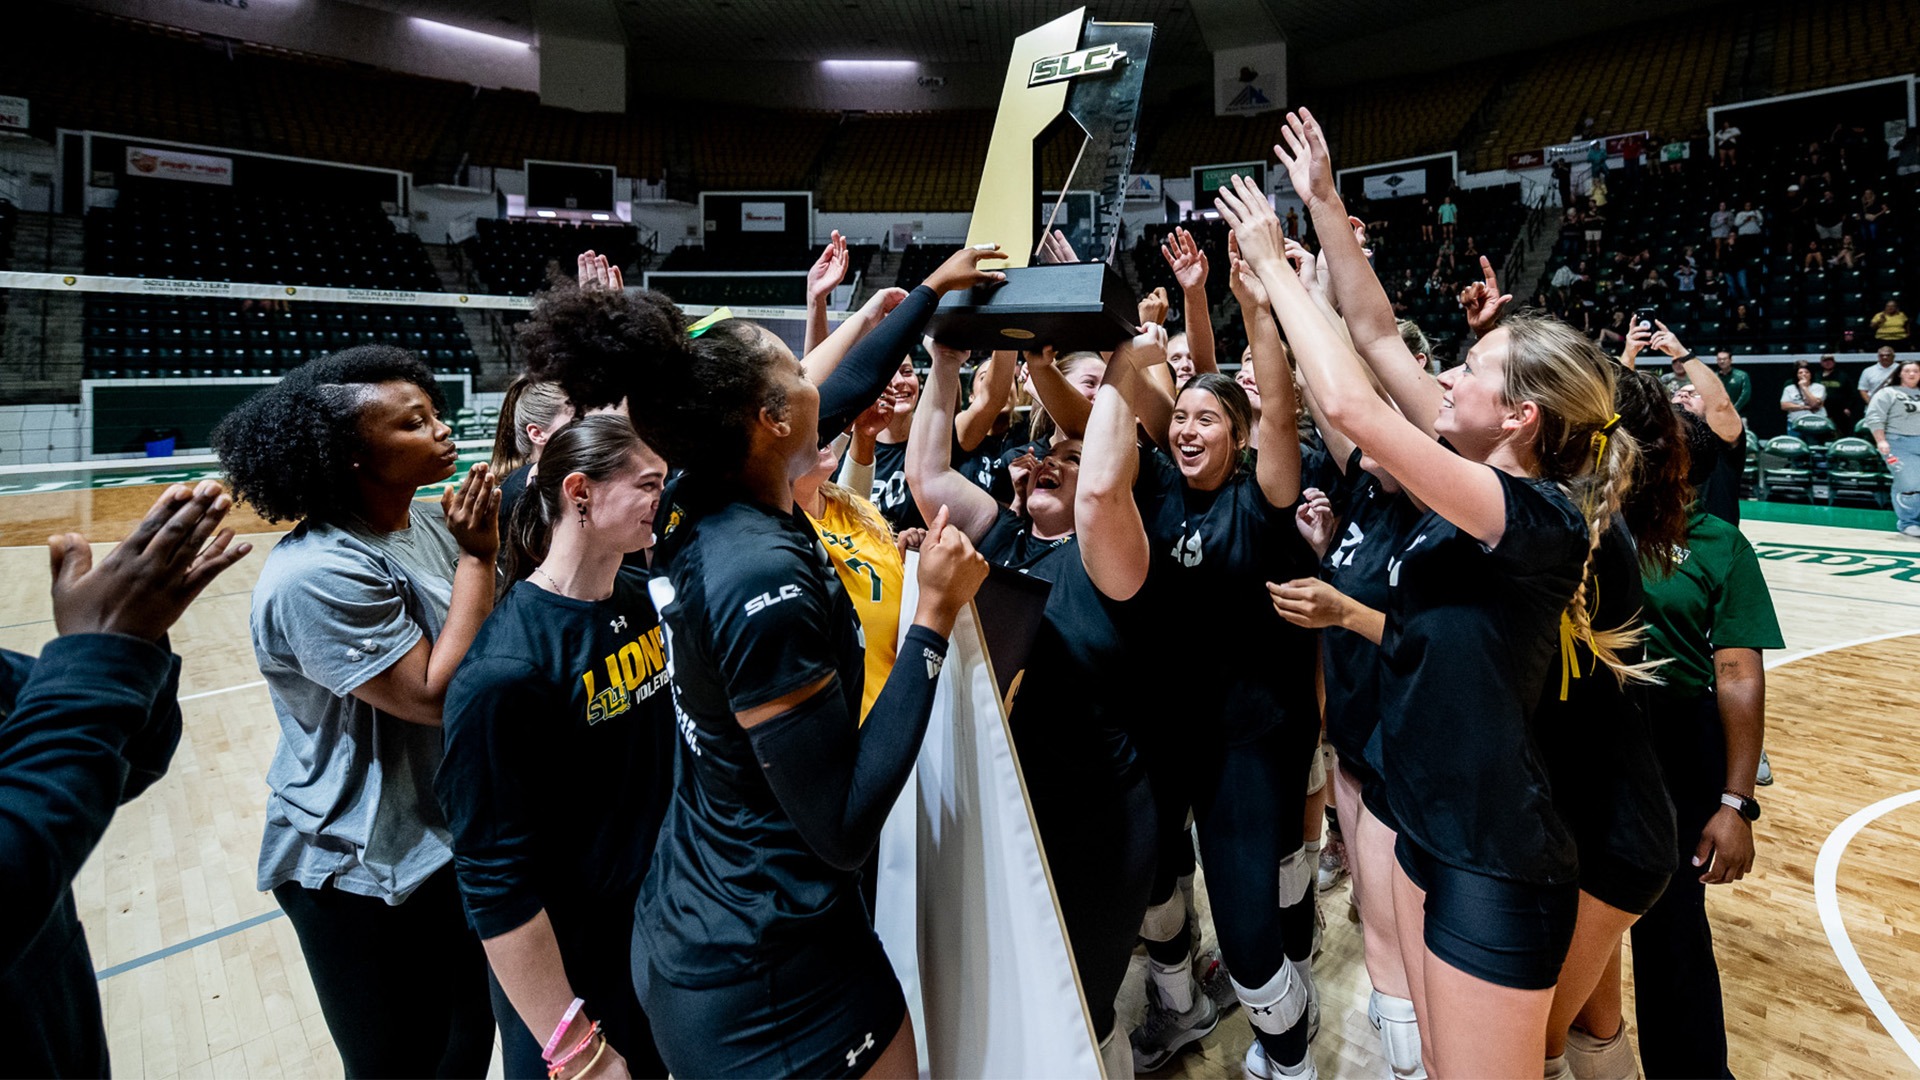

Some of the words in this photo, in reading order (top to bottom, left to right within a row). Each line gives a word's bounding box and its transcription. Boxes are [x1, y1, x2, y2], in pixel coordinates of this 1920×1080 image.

[1032, 47, 1112, 82] SLC
[1087, 98, 1135, 257] CHAMPION
[143, 279, 231, 289] SOUTHEASTERN
[744, 584, 800, 617] SLC
